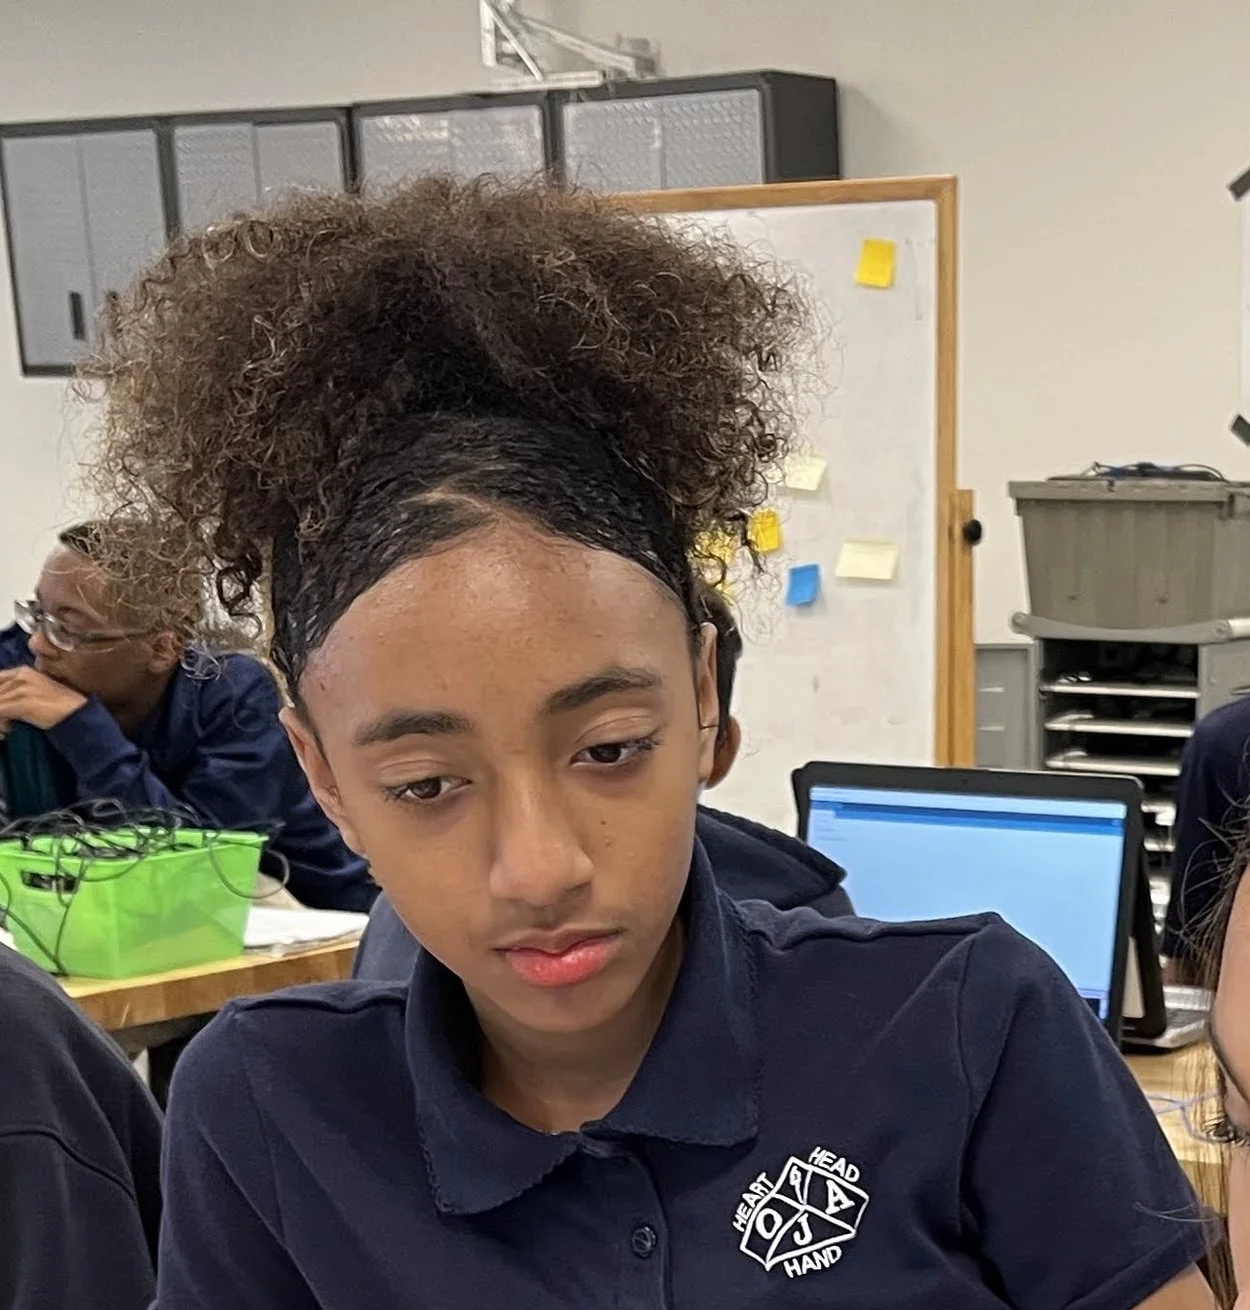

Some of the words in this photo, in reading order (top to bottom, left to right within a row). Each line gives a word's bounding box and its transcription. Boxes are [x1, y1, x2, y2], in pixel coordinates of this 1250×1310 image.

[808, 1146, 860, 1183] HEAD
[732, 1172, 774, 1232] HEART
[825, 1180, 855, 1215] A
[755, 1208, 783, 1240] O
[793, 1213, 813, 1246] J
[783, 1245, 842, 1278] HAND
